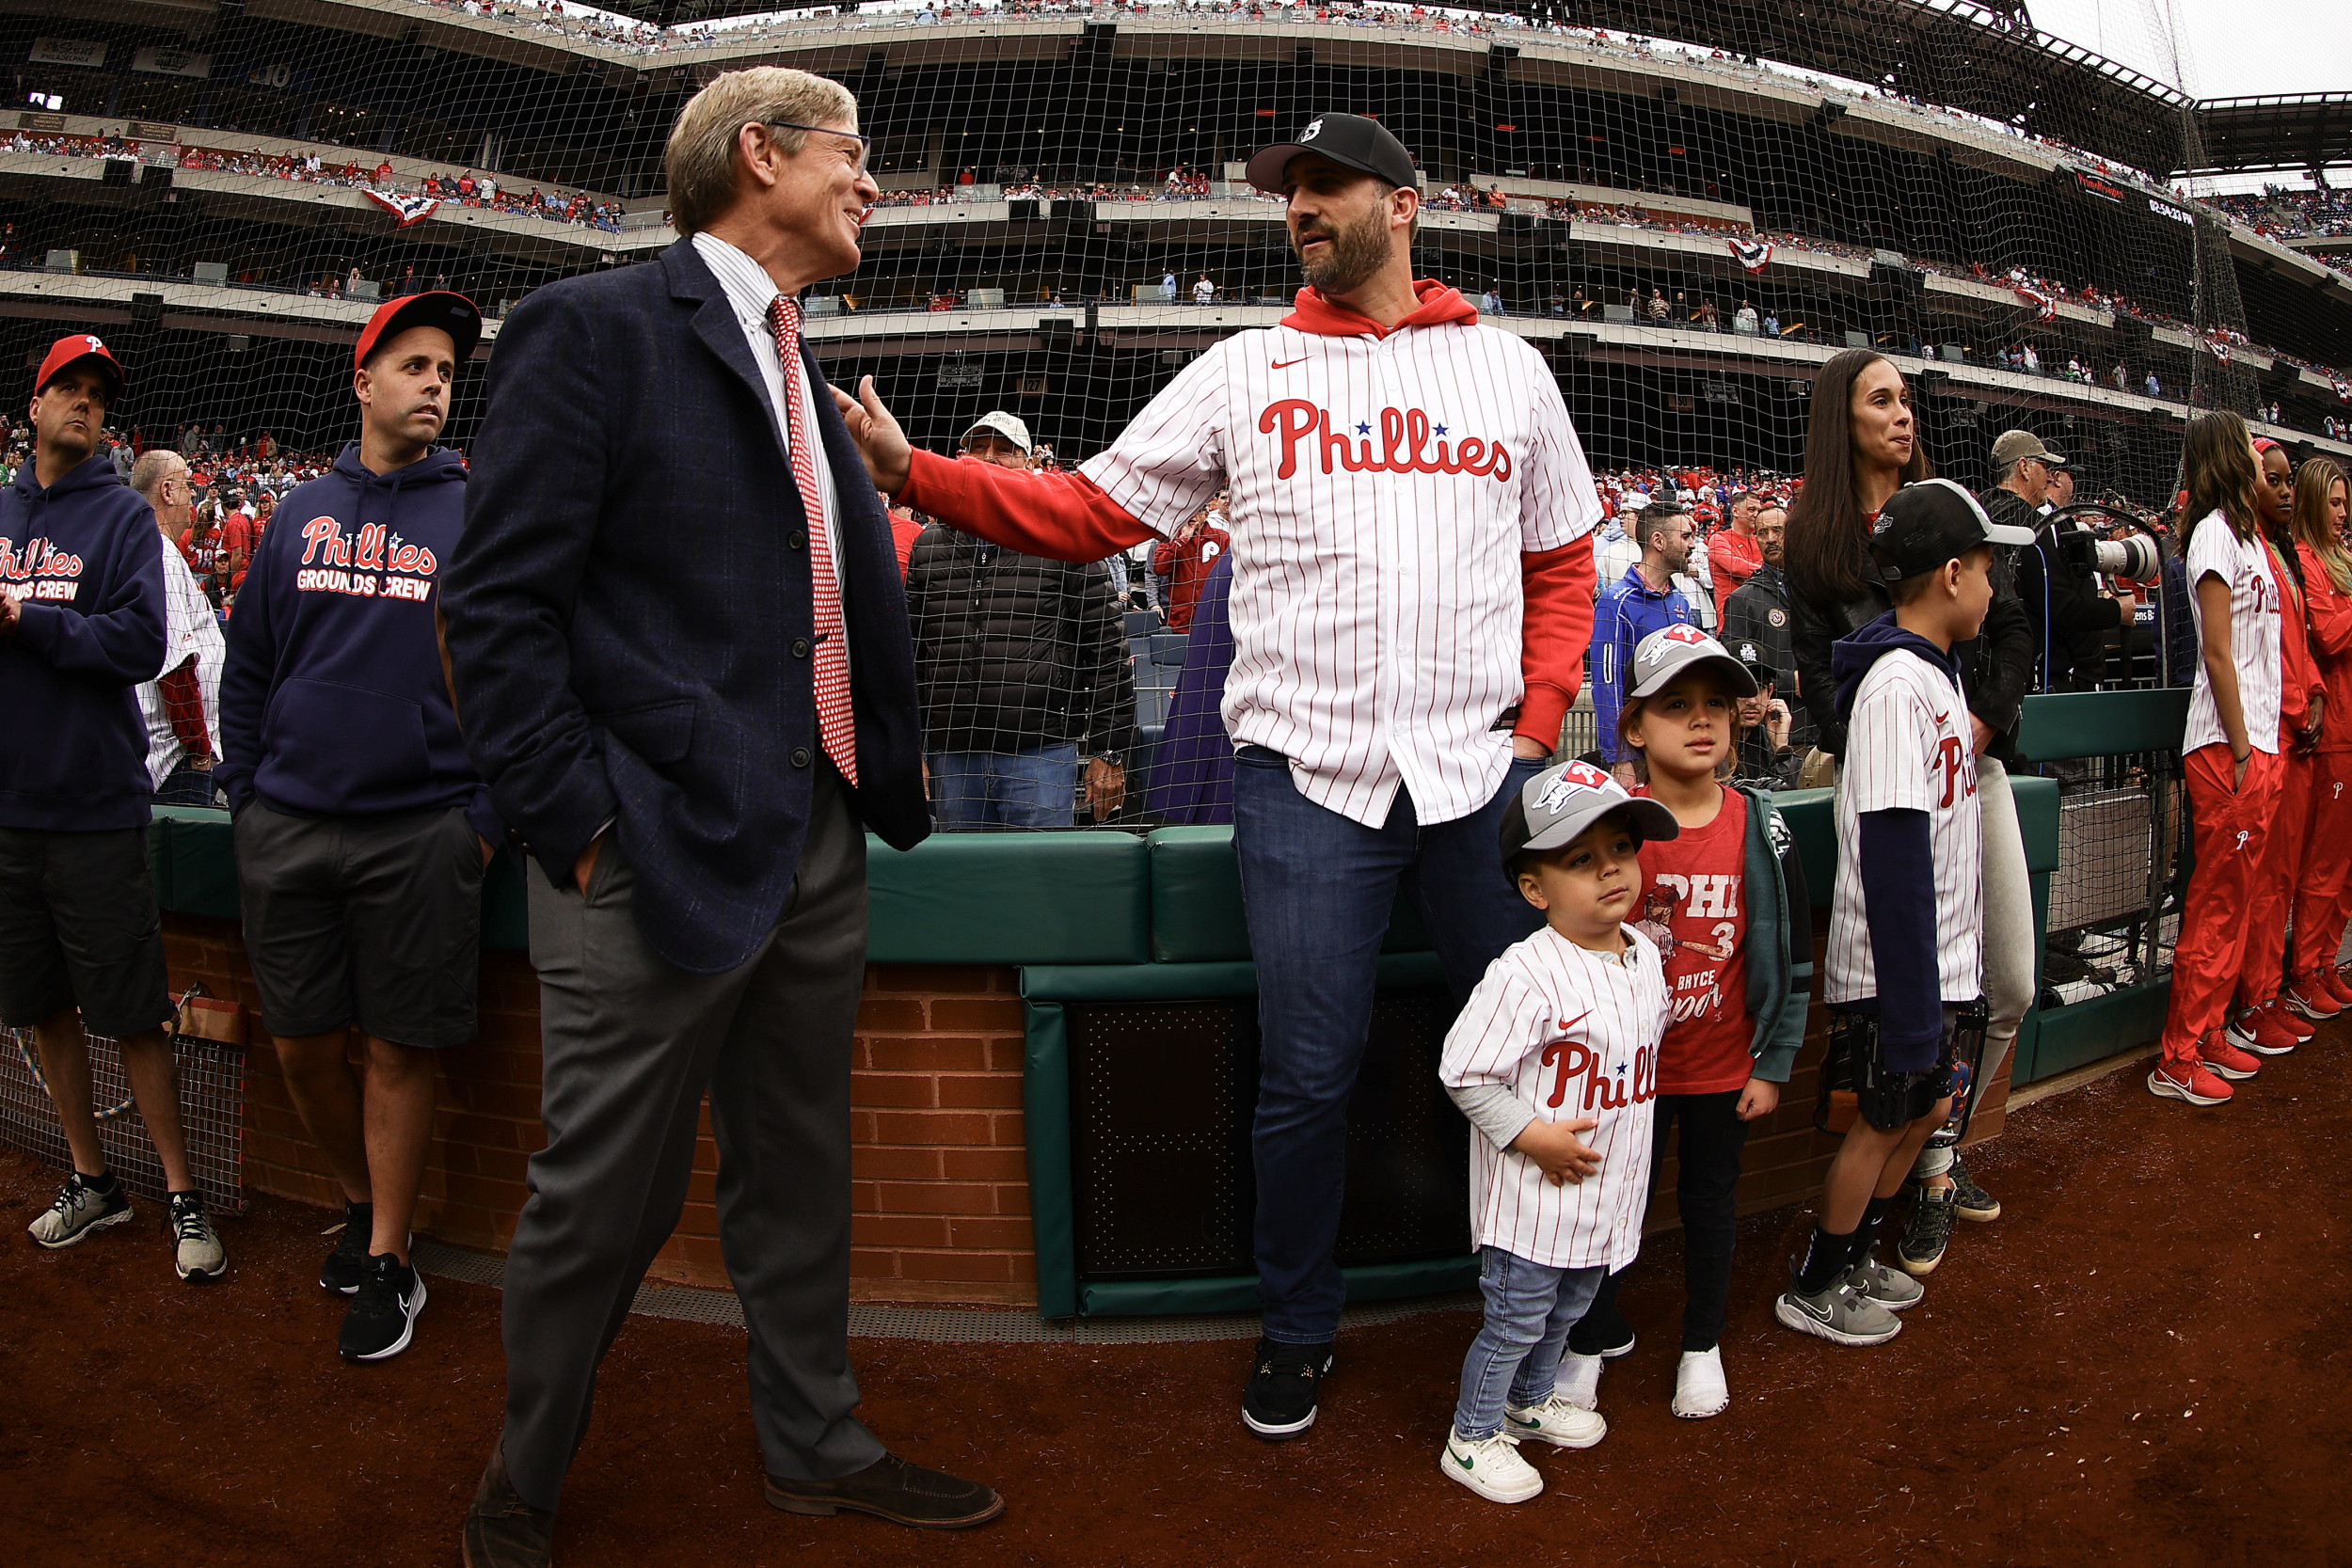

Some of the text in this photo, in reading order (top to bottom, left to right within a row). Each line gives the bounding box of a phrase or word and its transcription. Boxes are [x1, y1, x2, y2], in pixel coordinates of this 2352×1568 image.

[40, 54, 88, 63] PHILADELPHIA
[264, 65, 291, 87] 10
[86, 336, 103, 352] P
[1259, 399, 1511, 483] Phillies
[301, 515, 437, 576] Phillies
[1201, 541, 1220, 563] P
[195, 548, 214, 569] 18
[35, 580, 79, 602] CREW
[296, 568, 432, 603] GROUNDS CREW
[2133, 611, 2147, 621] ens
[1674, 626, 1695, 641] P
[1571, 765, 1596, 784] P
[2333, 782, 2344, 800] P
[2236, 830, 2249, 850] P
[1708, 921, 1736, 961] 3
[1677, 969, 1716, 990] BRYCE
[1541, 1040, 1656, 1111] Phill
